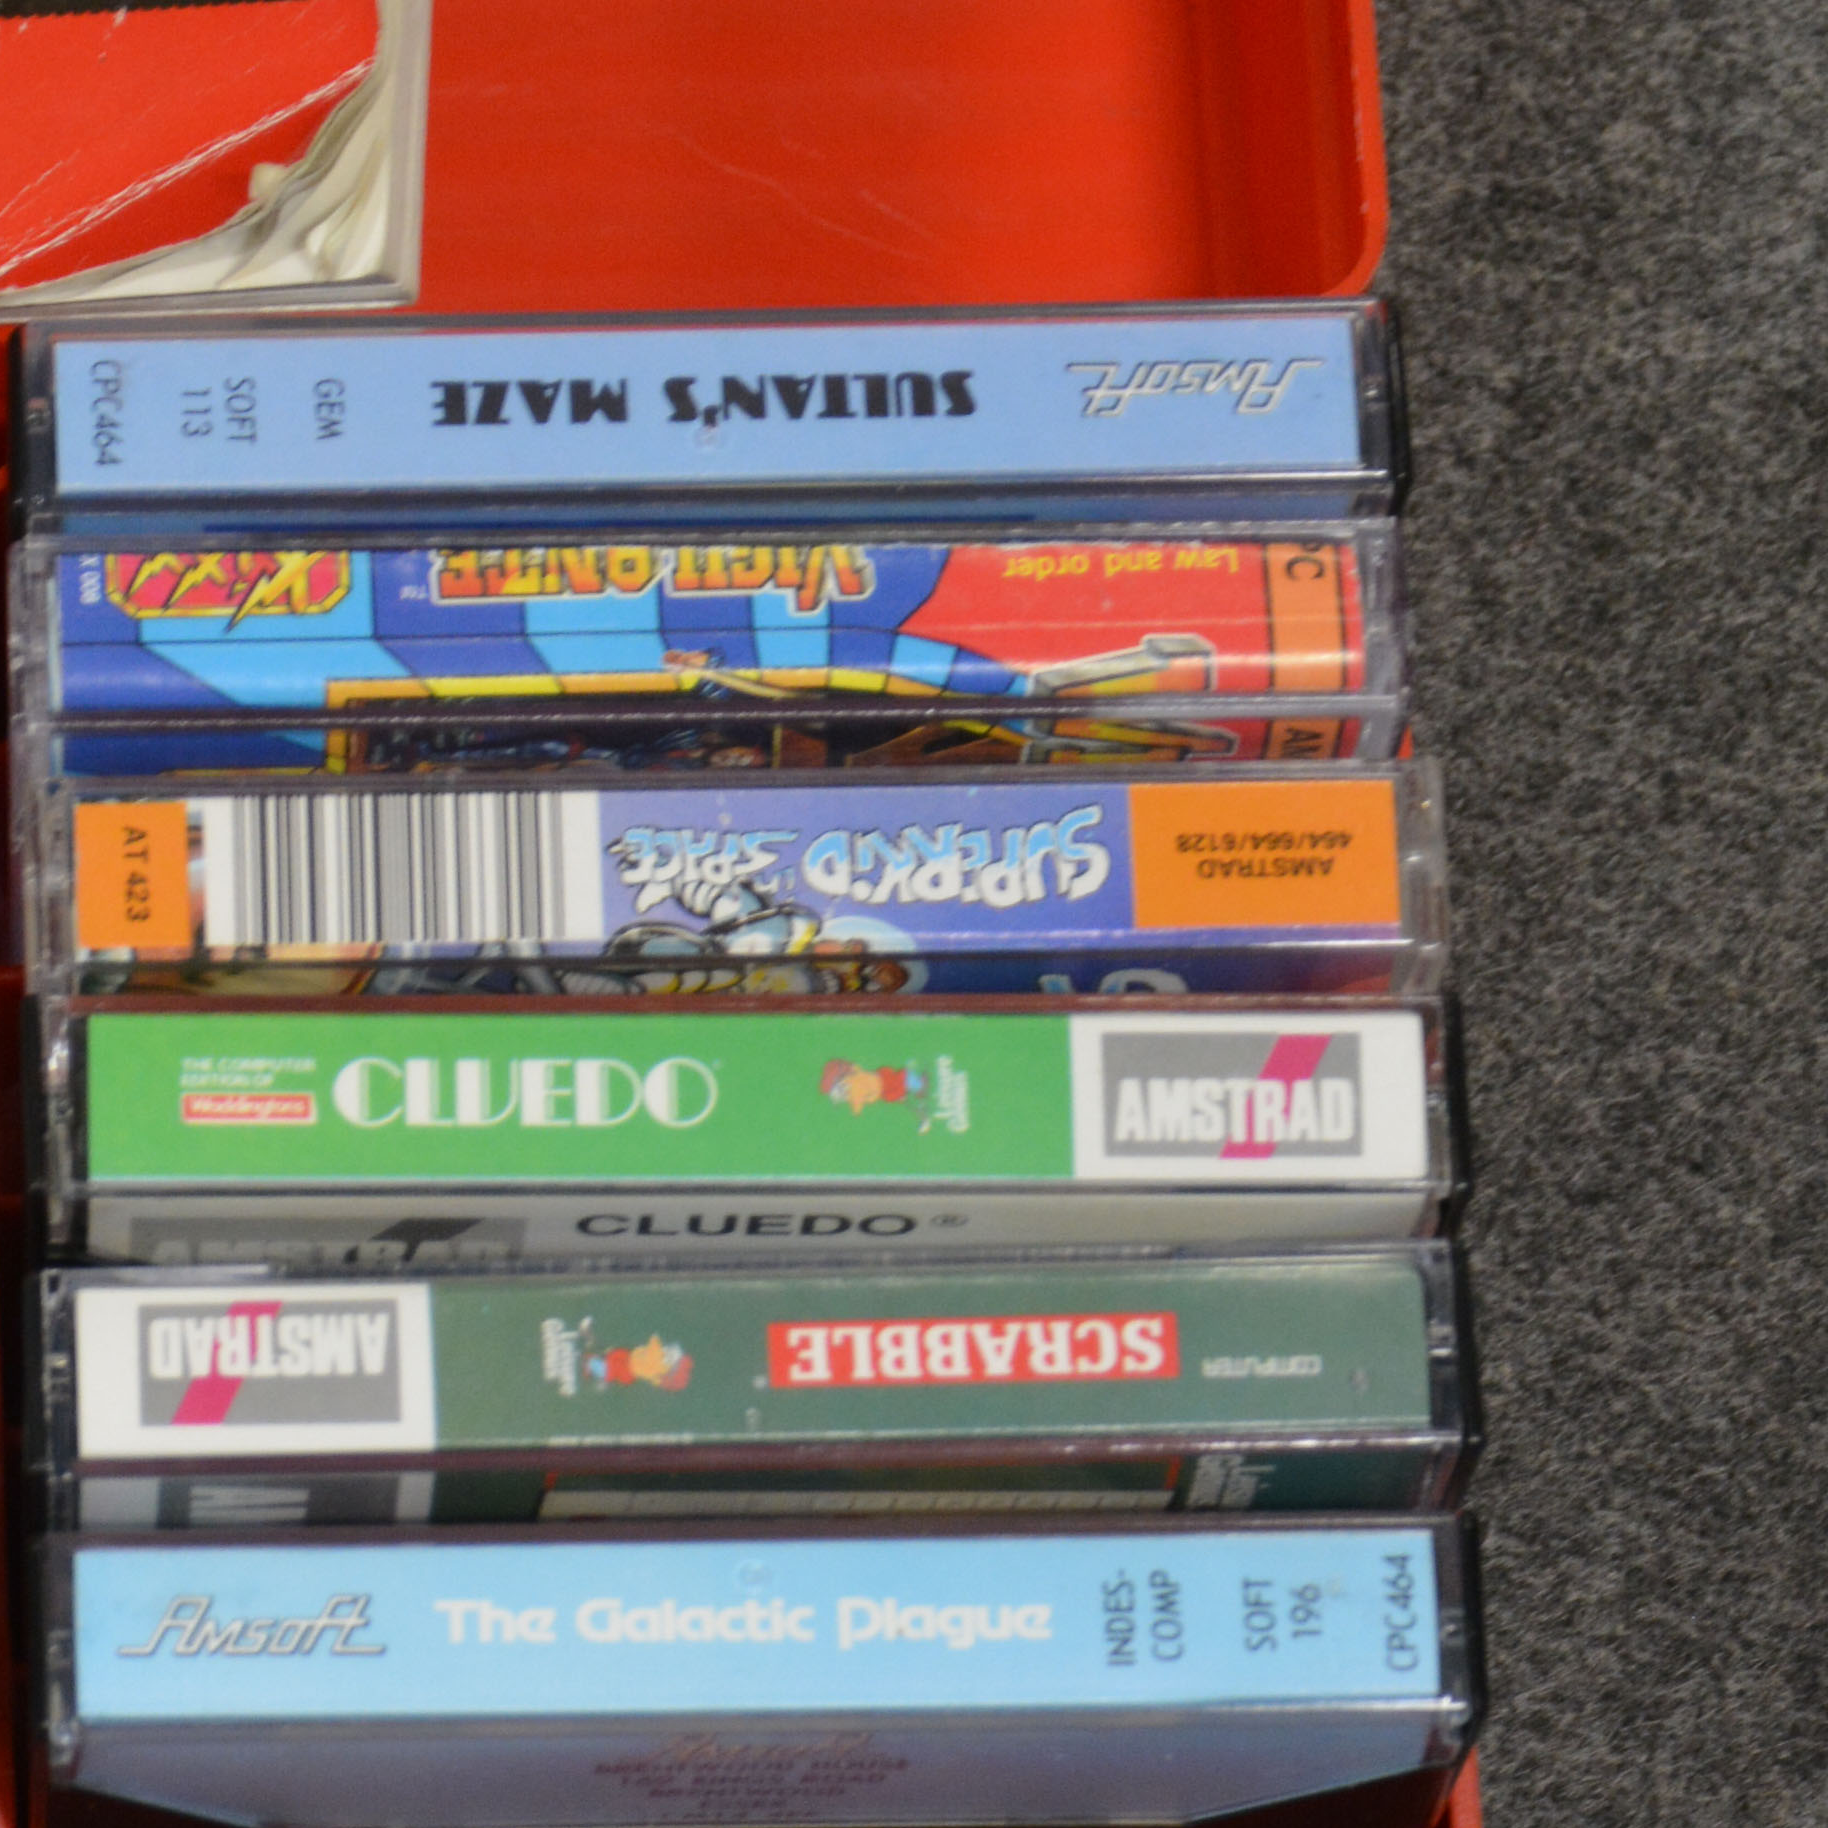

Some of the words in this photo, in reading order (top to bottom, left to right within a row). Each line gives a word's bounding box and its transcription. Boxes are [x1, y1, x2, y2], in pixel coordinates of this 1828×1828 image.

[89, 359, 123, 469] CPC464
[180, 386, 212, 440] 113
[224, 375, 257, 446] SOFT
[314, 377, 345, 441] GEM
[431, 375, 628, 428] MAZE
[663, 368, 977, 428] SULTAN'S
[1066, 356, 1324, 419] Amsoft
[1002, 553, 1089, 580] order
[1104, 551, 1162, 578] and
[1176, 546, 1239, 573] Law
[121, 825, 148, 864] AT
[1198, 858, 1333, 880] AMSTRAD
[125, 870, 153, 926] 423
[332, 1056, 718, 1128] CLUEDO
[1114, 1077, 1356, 1144] AMSTRAD
[575, 1212, 918, 1238] CLUEDO
[147, 1312, 391, 1381] AMSTRAD
[786, 1316, 1165, 1383] SCRABBLE
[116, 1594, 387, 1658] Amsoft
[434, 1598, 557, 1644] The
[575, 1596, 817, 1644] Galactic
[836, 1596, 1054, 1649] Plague
[1106, 1569, 1137, 1668] INDES-
[1151, 1570, 1183, 1663] COMP
[1244, 1577, 1278, 1653] SOFT
[1290, 1581, 1323, 1640] 196
[1383, 1552, 1419, 1673] CPC464
